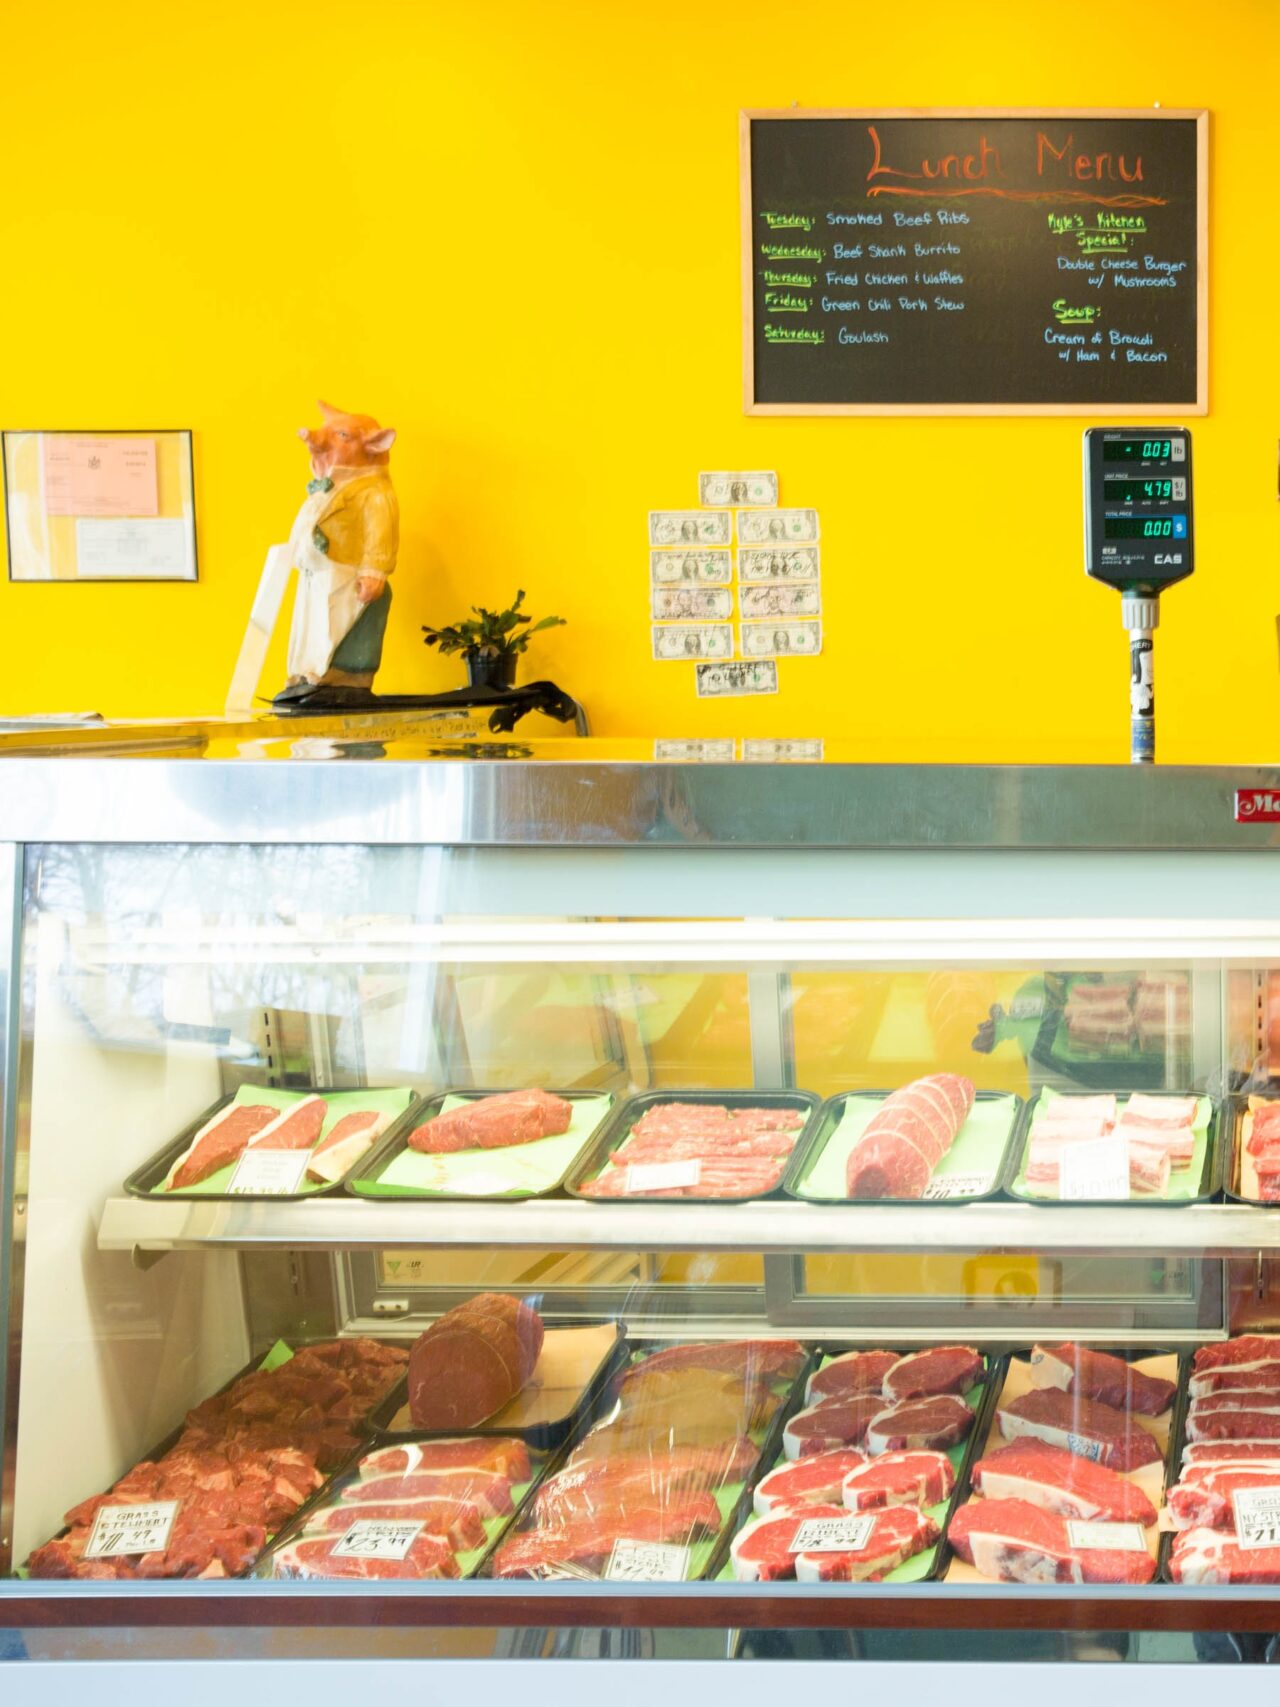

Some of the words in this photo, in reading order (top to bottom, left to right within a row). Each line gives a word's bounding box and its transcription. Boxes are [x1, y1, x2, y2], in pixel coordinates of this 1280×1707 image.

[866, 126, 1006, 181] Lunch
[1036, 130, 1144, 182] Menu
[760, 211, 816, 231] Tuesday:
[826, 212, 883, 225] Smoked
[893, 212, 932, 226] Beef
[936, 211, 970, 225] Ribs
[1097, 211, 1145, 227] Kitchen
[1076, 231, 1134, 250] Special:
[761, 243, 826, 263] Wednesday:
[833, 244, 863, 259] Beef
[868, 244, 906, 258] Shank
[914, 242, 961, 256] Burrito
[1057, 256, 1095, 270] Double
[1101, 257, 1138, 269] Cheese
[1144, 255, 1187, 275] Burger
[759, 271, 817, 288] Thursday:
[826, 271, 858, 285] Fried
[865, 272, 908, 285] Chicken
[922, 270, 964, 284] Waffles
[1088, 274, 1104, 288] w/
[1114, 273, 1177, 287] Mushrooms
[765, 293, 813, 311] Friday:
[821, 296, 860, 312] Green
[868, 298, 891, 311] Chili
[899, 297, 928, 311] Pork
[934, 297, 965, 310] Stew
[1052, 298, 1101, 320] Soup:
[764, 324, 825, 343] Saturday:
[838, 326, 888, 344] Goulash
[1044, 327, 1085, 344] Cream
[1091, 330, 1102, 344] of
[1058, 349, 1070, 361] w/
[1077, 349, 1100, 361] Ham
[1126, 350, 1168, 363] Bacon
[1144, 521, 1171, 536] 0.00
[1154, 554, 1182, 564] CAS
